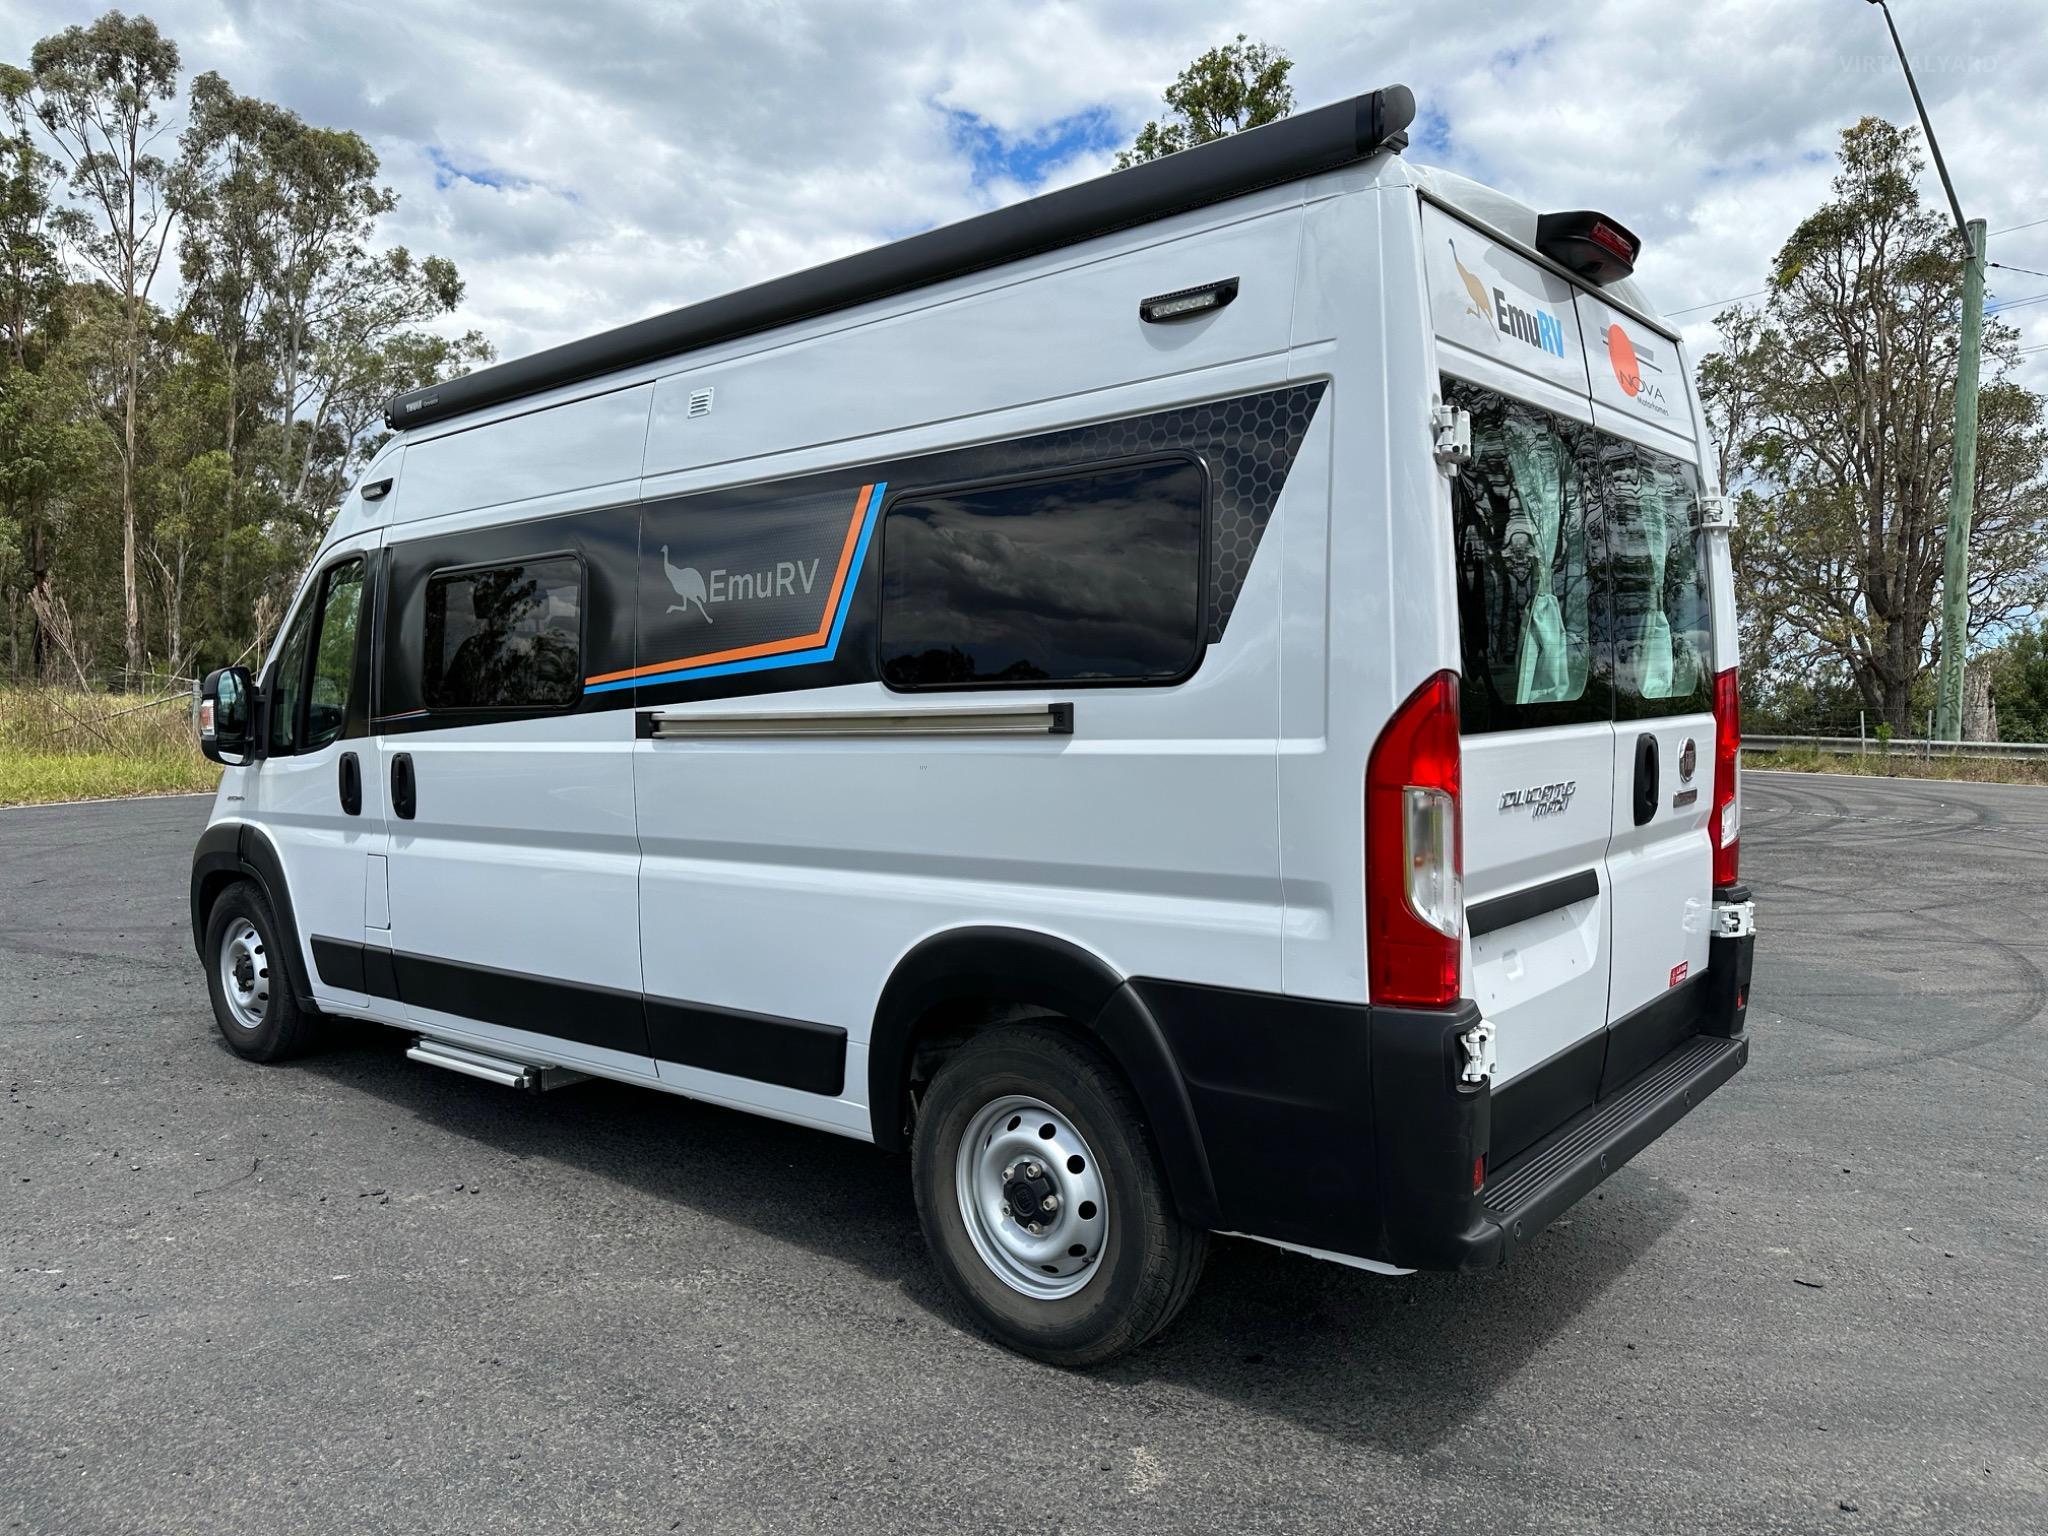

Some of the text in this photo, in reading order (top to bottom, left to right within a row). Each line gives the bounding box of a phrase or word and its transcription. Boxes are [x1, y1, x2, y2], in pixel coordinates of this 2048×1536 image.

[1492, 286, 1564, 359] EmuRV
[1618, 369, 1666, 403] NOVA
[709, 558, 820, 603] EmuRV
